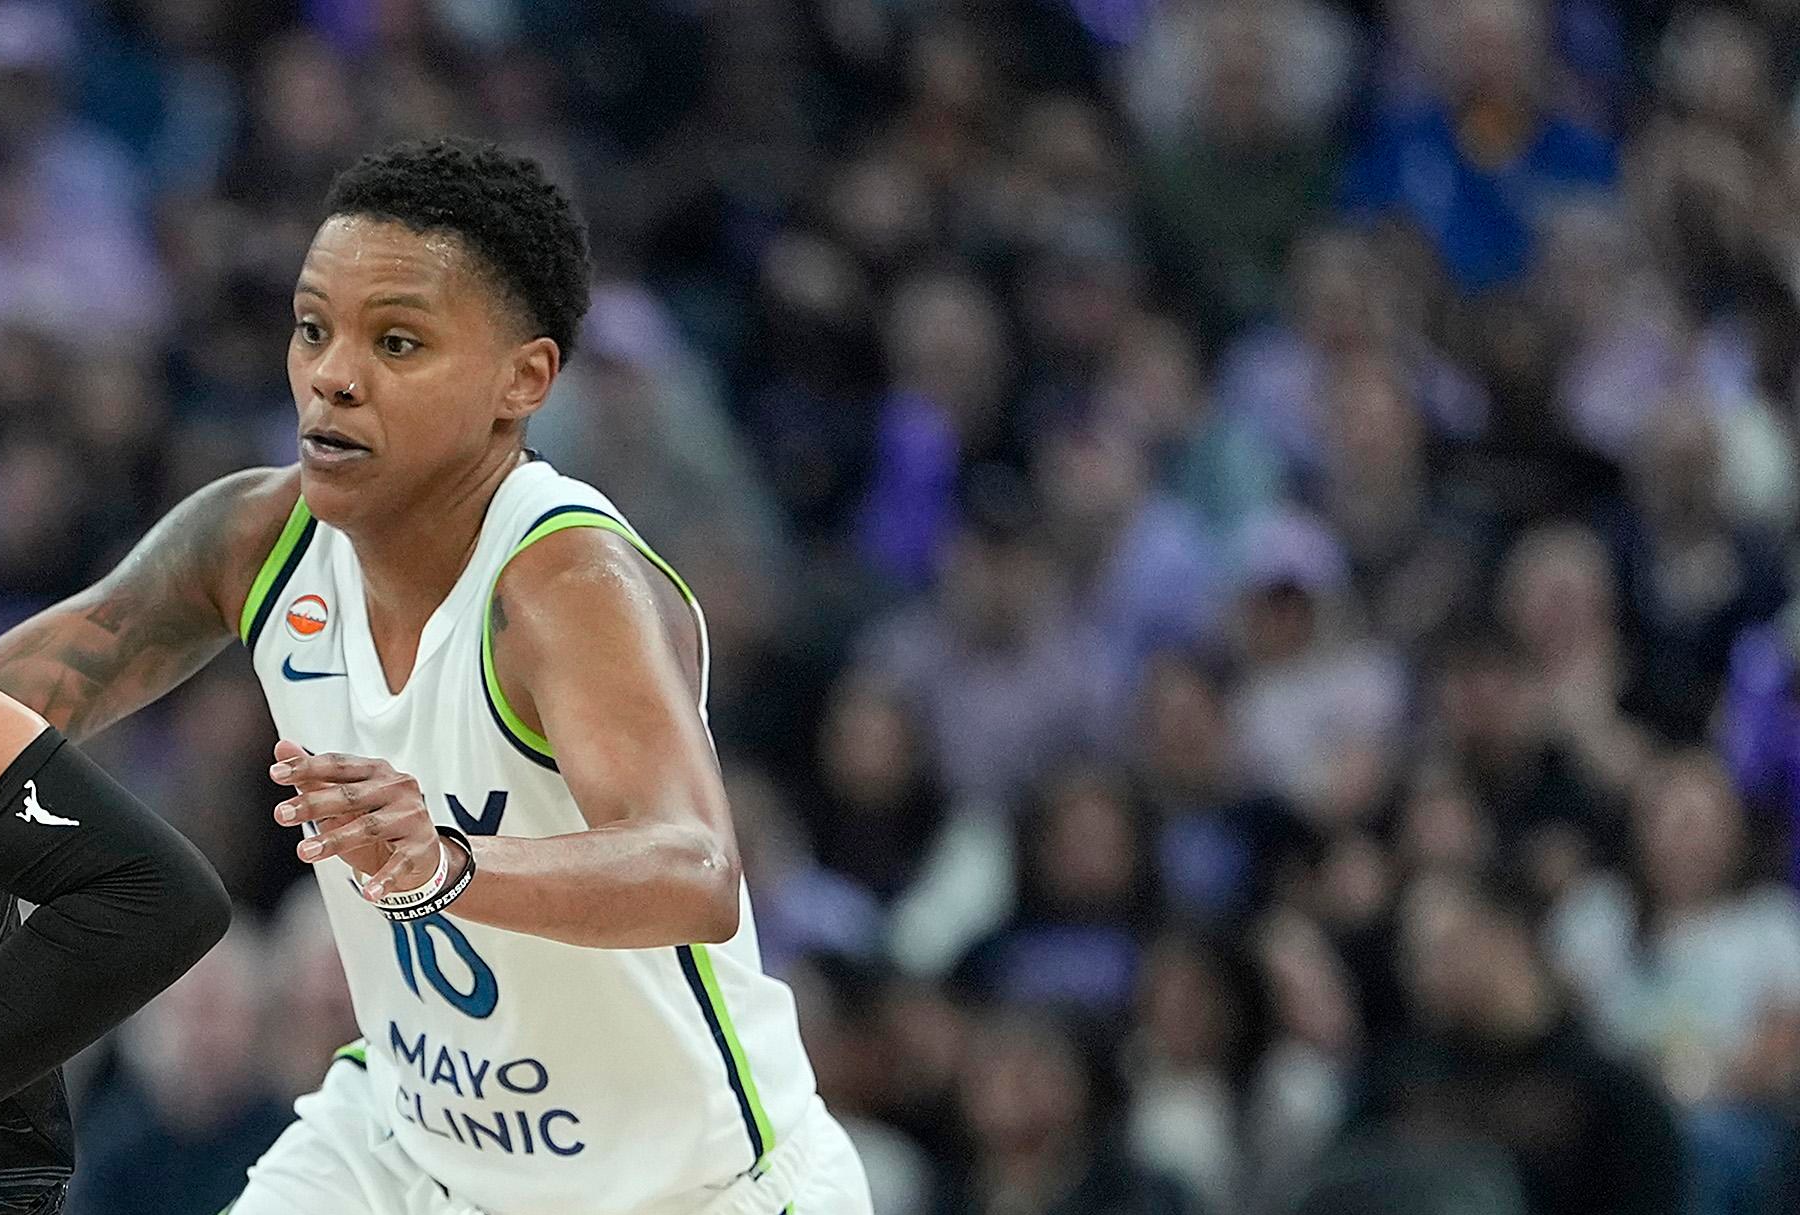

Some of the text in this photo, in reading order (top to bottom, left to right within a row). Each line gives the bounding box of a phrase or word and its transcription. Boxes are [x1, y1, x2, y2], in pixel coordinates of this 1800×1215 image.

[393, 870, 472, 920] BLACK PERSON
[389, 1020, 549, 1100] MAYO
[395, 1084, 586, 1156] CLINIC
